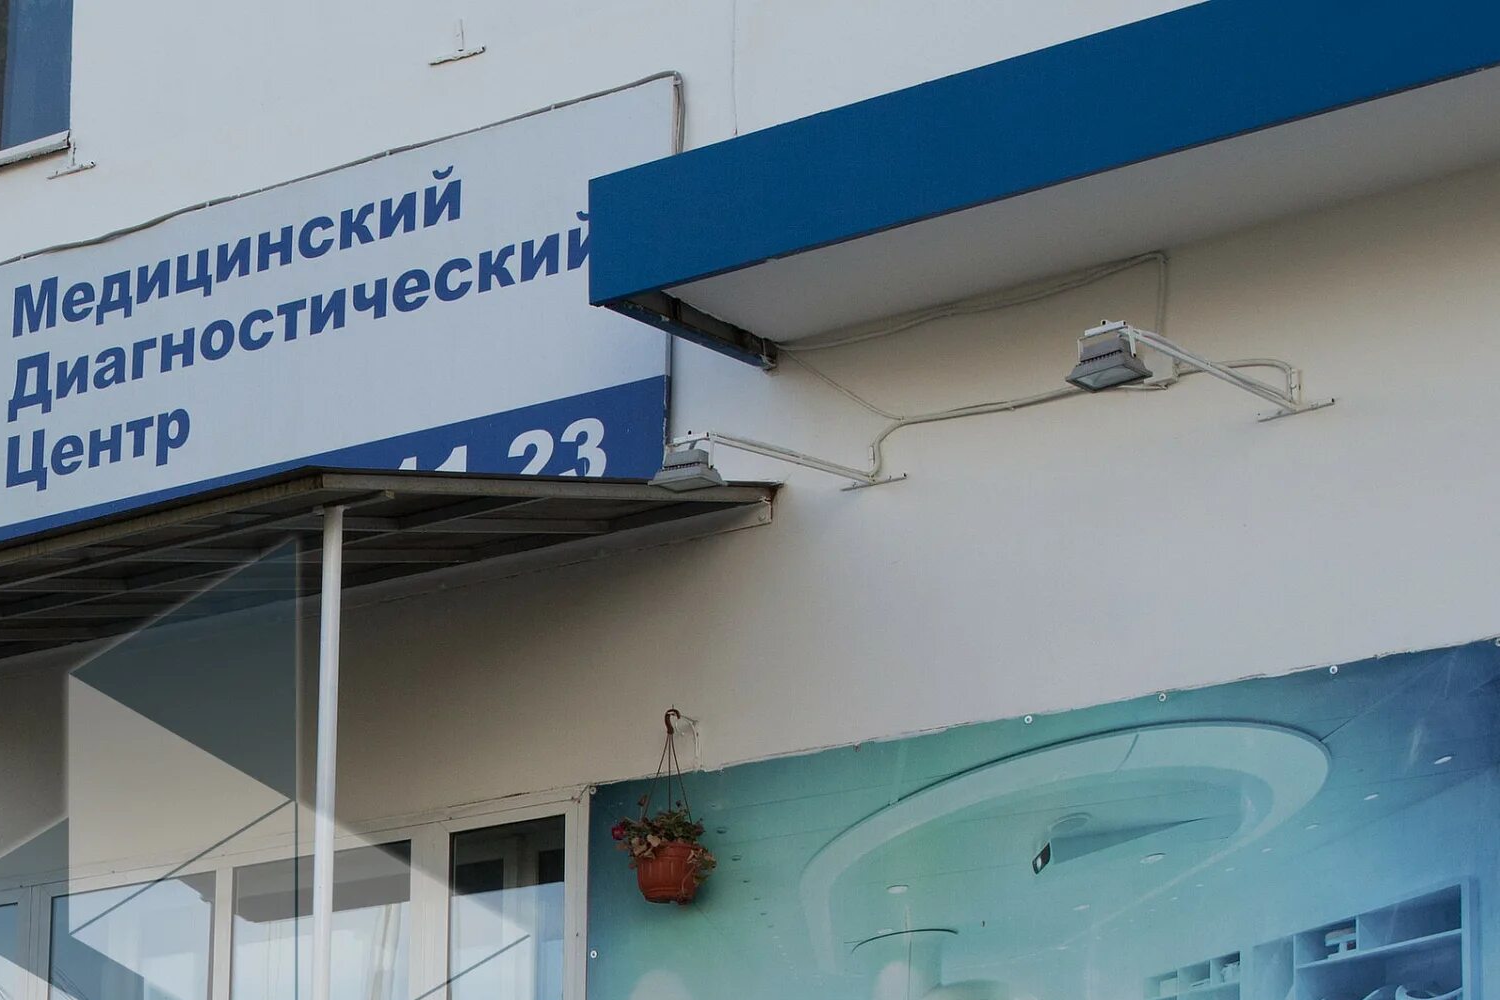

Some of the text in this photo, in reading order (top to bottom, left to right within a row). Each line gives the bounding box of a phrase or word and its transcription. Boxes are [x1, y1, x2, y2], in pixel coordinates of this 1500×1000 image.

[7, 211, 590, 423] Диагностический
[11, 166, 462, 338] Медицинский
[6, 409, 191, 492] Центр
